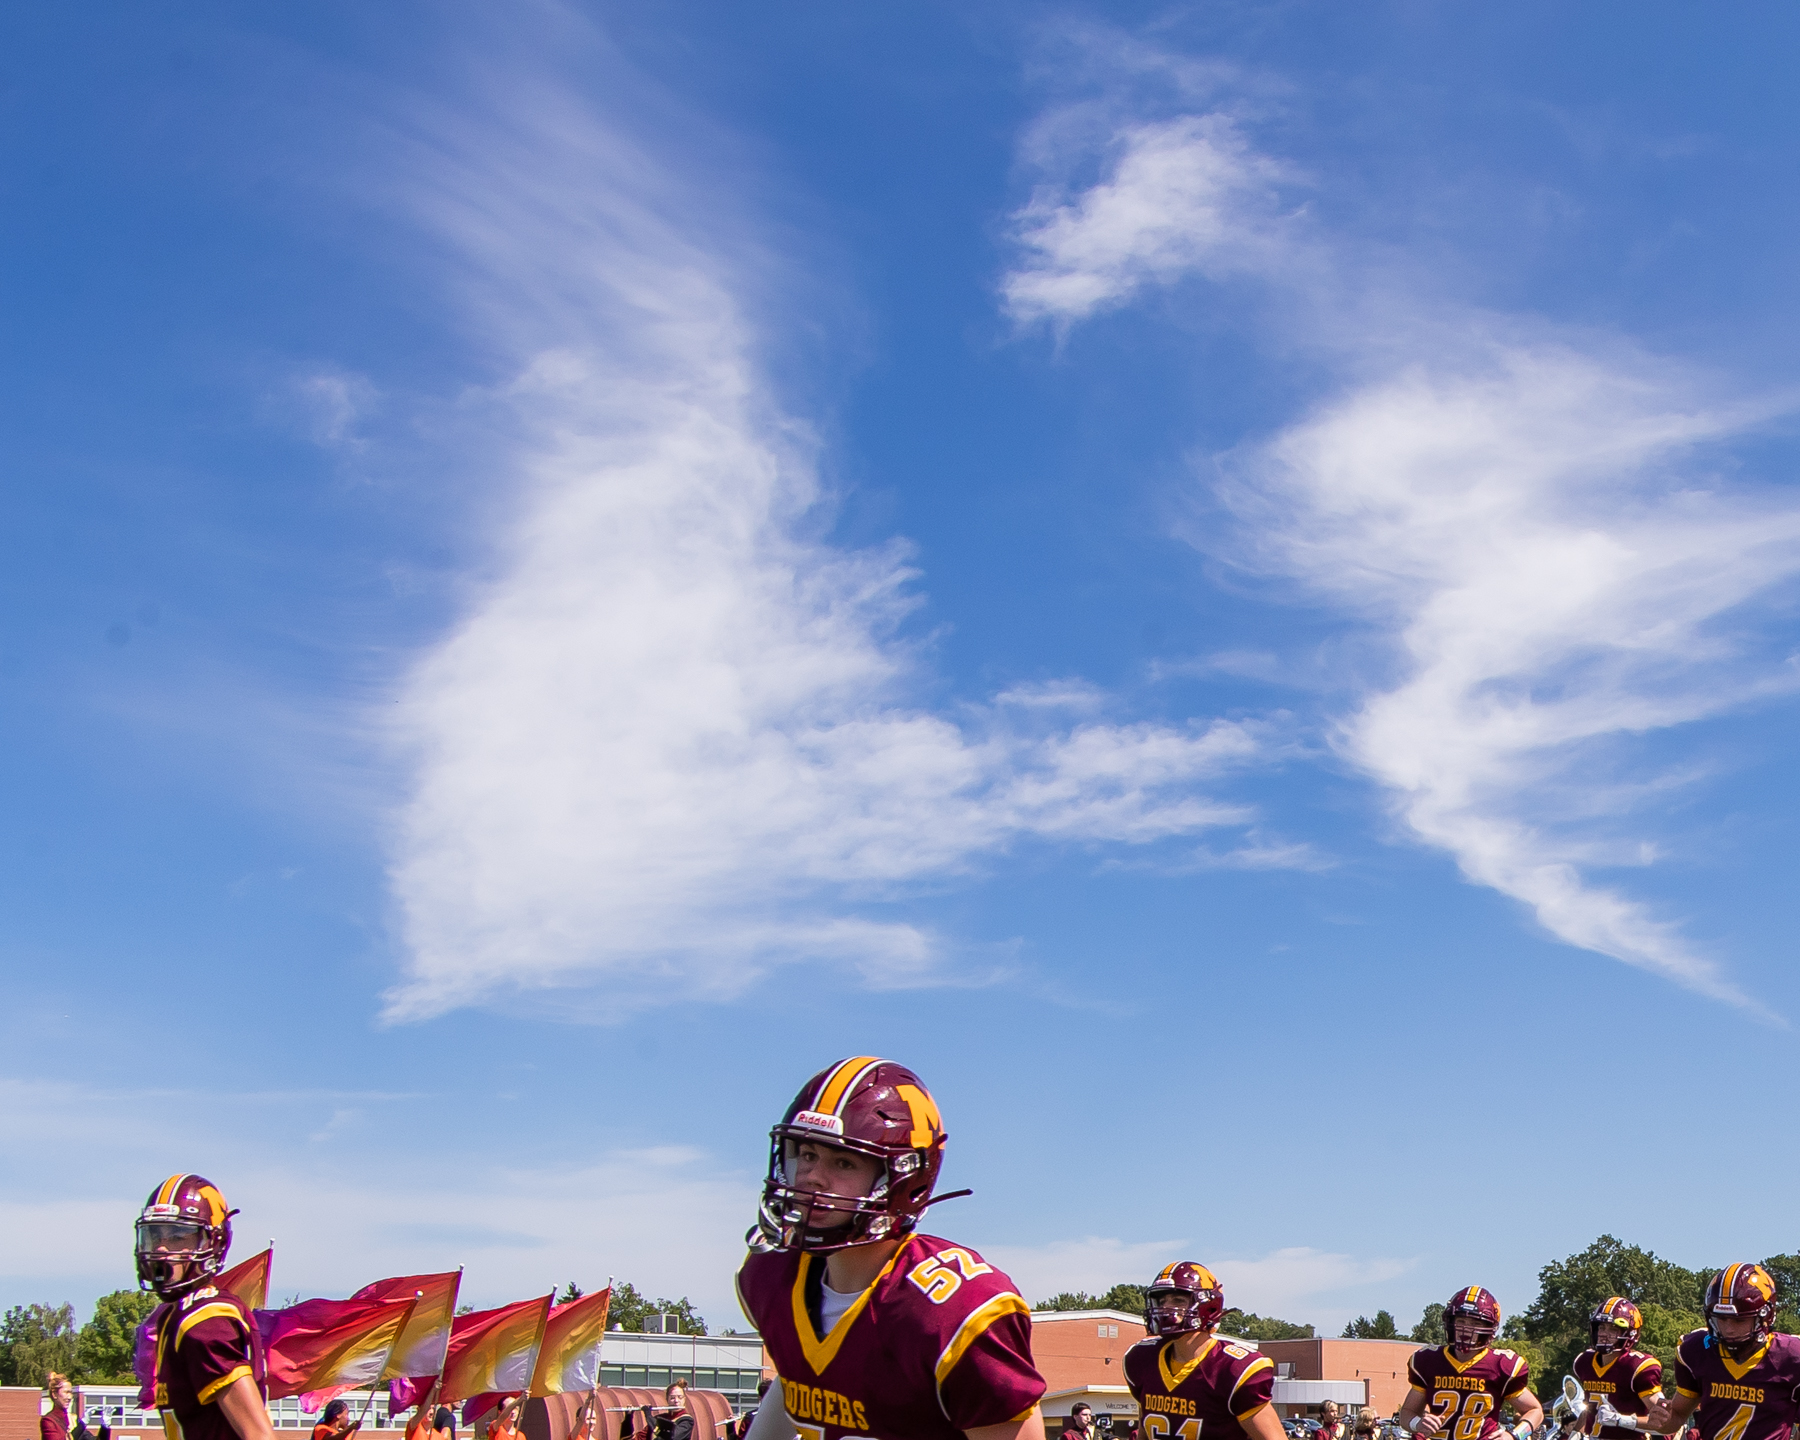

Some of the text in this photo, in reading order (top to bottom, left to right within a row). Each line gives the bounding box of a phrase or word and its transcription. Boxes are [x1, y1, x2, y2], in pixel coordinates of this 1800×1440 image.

[798, 1113, 836, 1129] Riddell
[906, 1248, 993, 1304] 52
[1434, 1376, 1486, 1392] DODGERS
[1710, 1383, 1764, 1402] DODGERS
[1145, 1394, 1196, 1416] DODGERS
